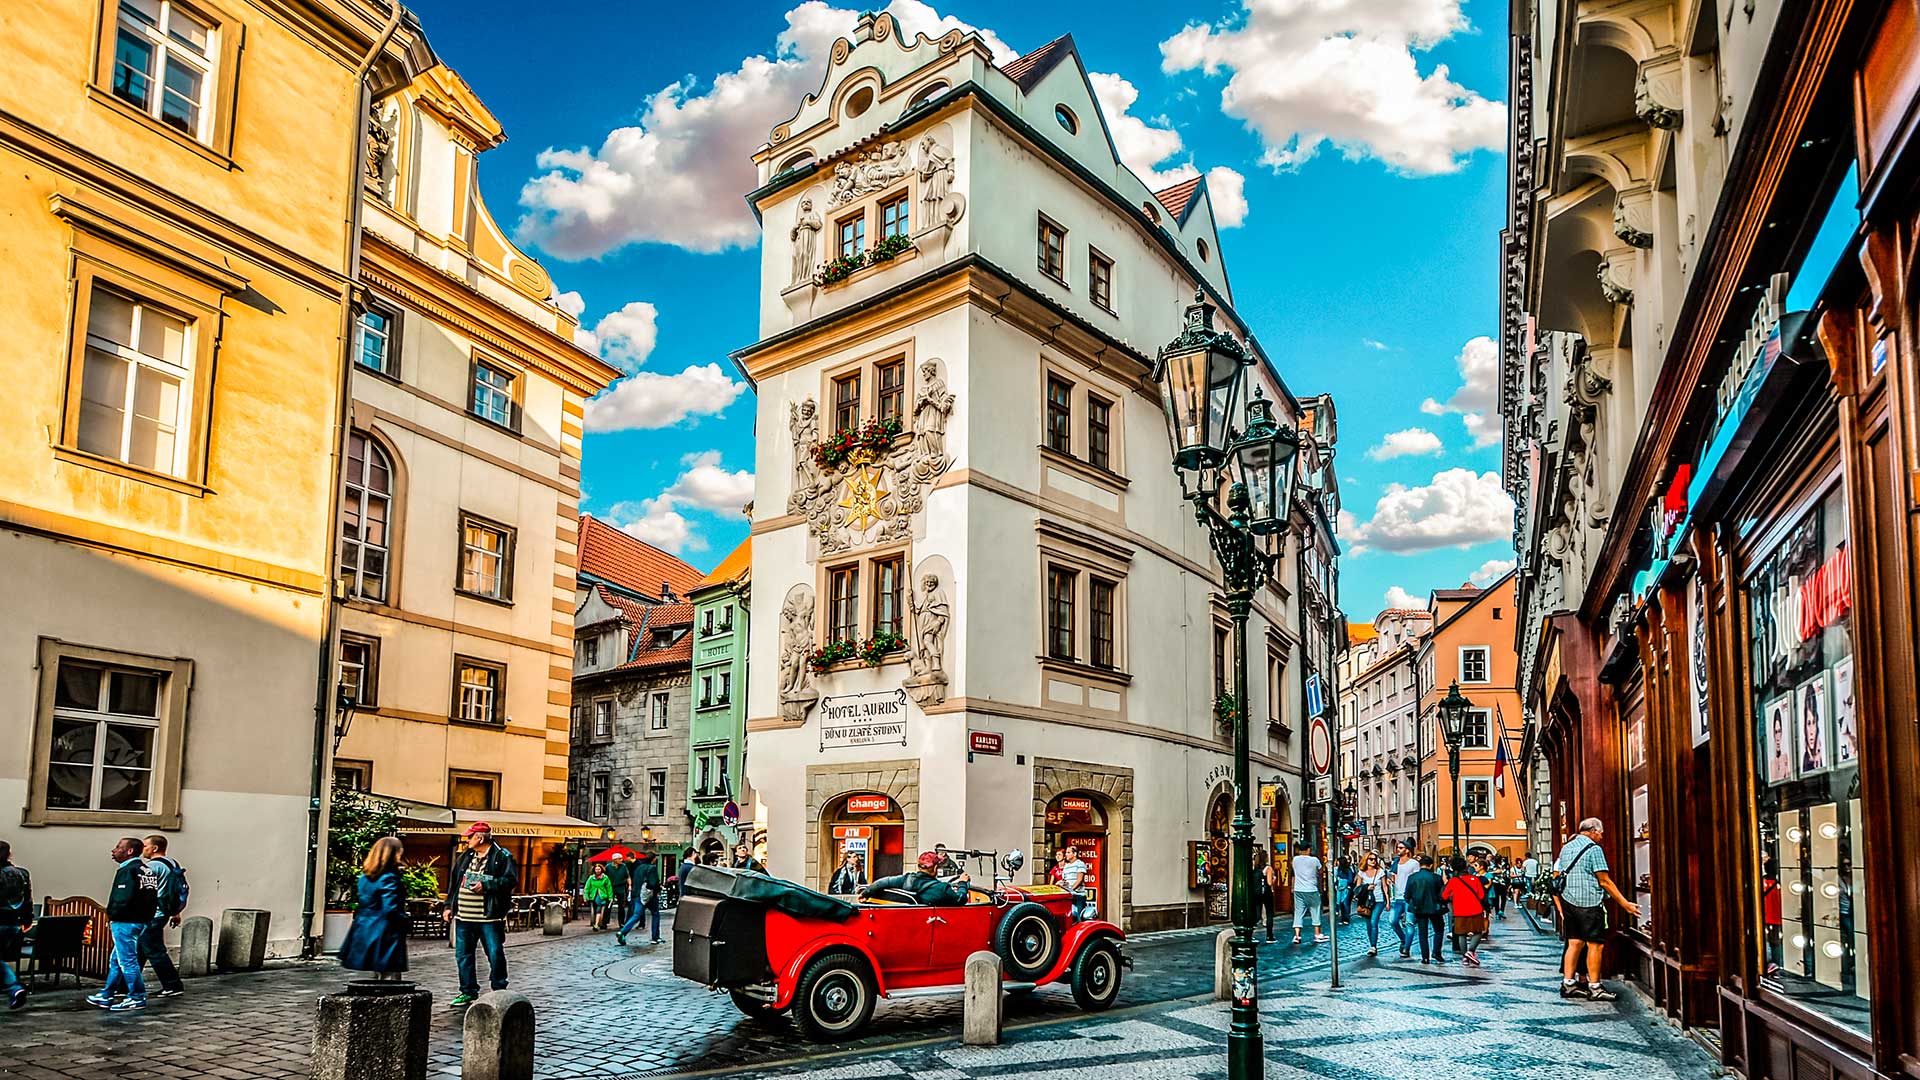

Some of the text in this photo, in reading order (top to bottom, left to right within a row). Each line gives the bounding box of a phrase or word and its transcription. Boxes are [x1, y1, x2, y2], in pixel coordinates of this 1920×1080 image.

[707, 645, 729, 657] HOTEL
[828, 701, 899, 720] HOTEL AURUS
[842, 729, 847, 738] U
[873, 724, 903, 736] STUDNY
[1204, 764, 1234, 790] KERAMI
[850, 799, 886, 809] change
[1063, 800, 1089, 808] CHANGE
[492, 826, 540, 836] RESTAURANT
[844, 828, 860, 837] ATM
[849, 841, 867, 849] ATM
[1071, 838, 1096, 846] CHANGE
